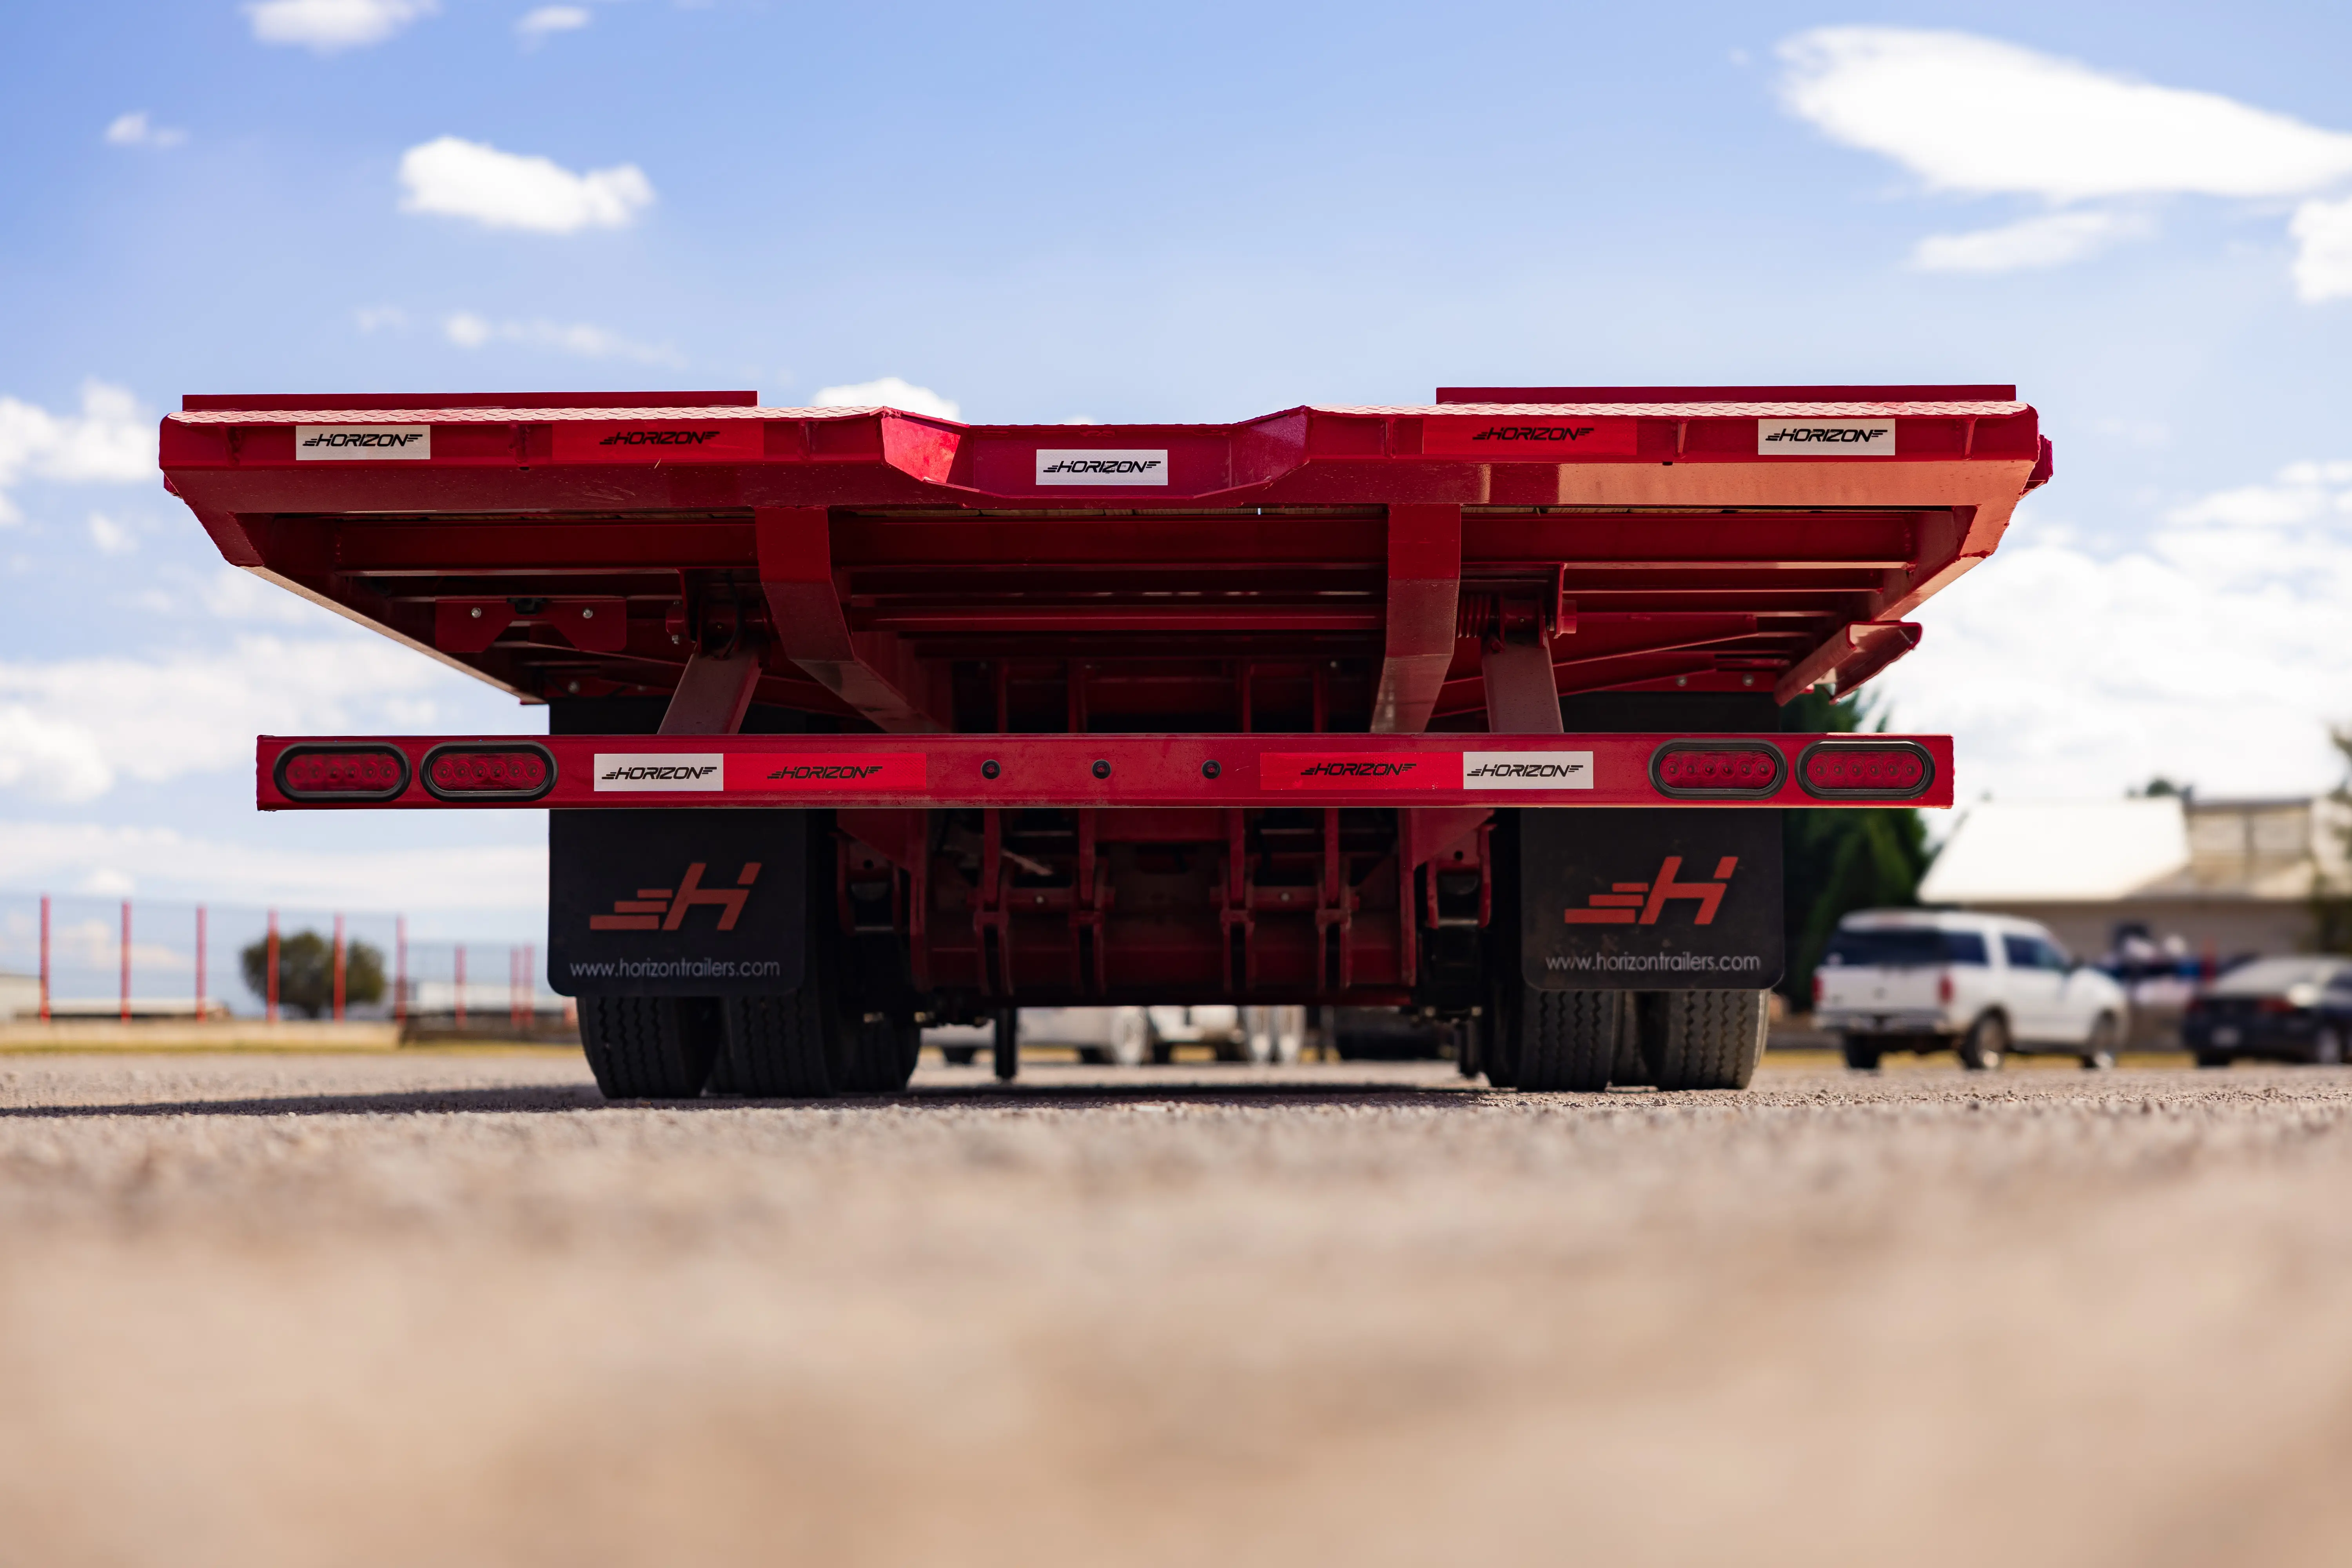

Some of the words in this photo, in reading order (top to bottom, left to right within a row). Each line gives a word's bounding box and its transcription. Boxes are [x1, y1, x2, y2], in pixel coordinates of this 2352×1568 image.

[316, 434, 409, 446] HORIZON
[613, 431, 706, 445] HORIZON
[1486, 427, 1581, 440] HORIZON
[1779, 428, 1874, 442] HORIZON
[1056, 461, 1148, 473] HORIZON
[615, 767, 704, 780] HORIZON
[780, 766, 870, 779] HORIZON
[1314, 763, 1404, 776] HORIZON
[1480, 764, 1570, 777] HORIZON
[570, 957, 780, 977] www.horizontrailers.com
[1545, 951, 1761, 971] www.horizontrailers.com
